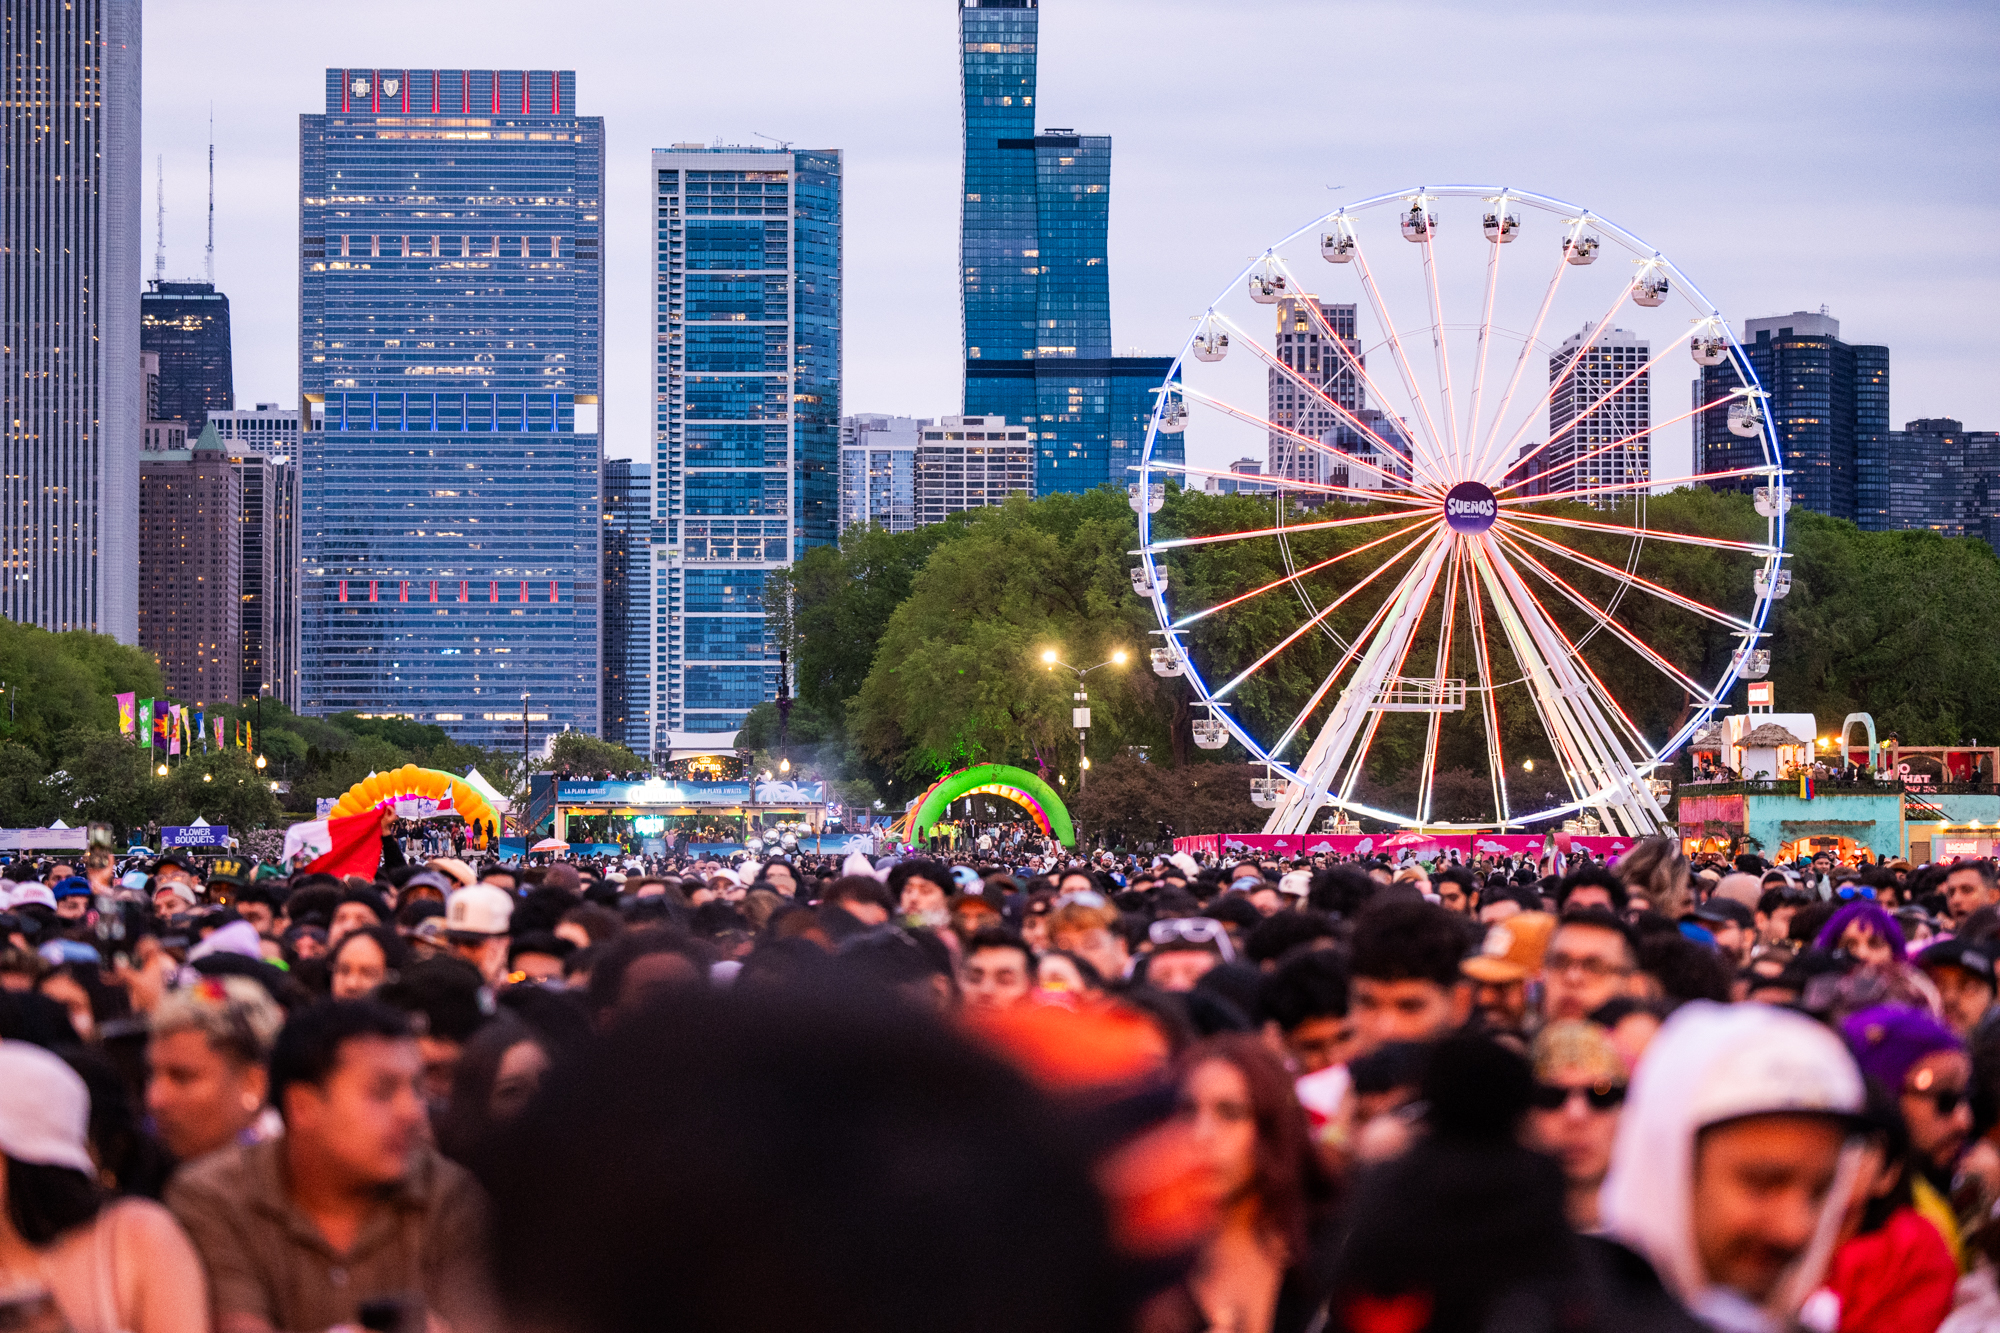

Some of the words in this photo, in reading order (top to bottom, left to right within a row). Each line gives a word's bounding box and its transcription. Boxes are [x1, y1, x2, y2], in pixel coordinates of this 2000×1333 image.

[1448, 498, 1494, 516] SUEÑOS
[180, 828, 211, 836] FLOWER
[175, 836, 215, 845] BOUQUETS
